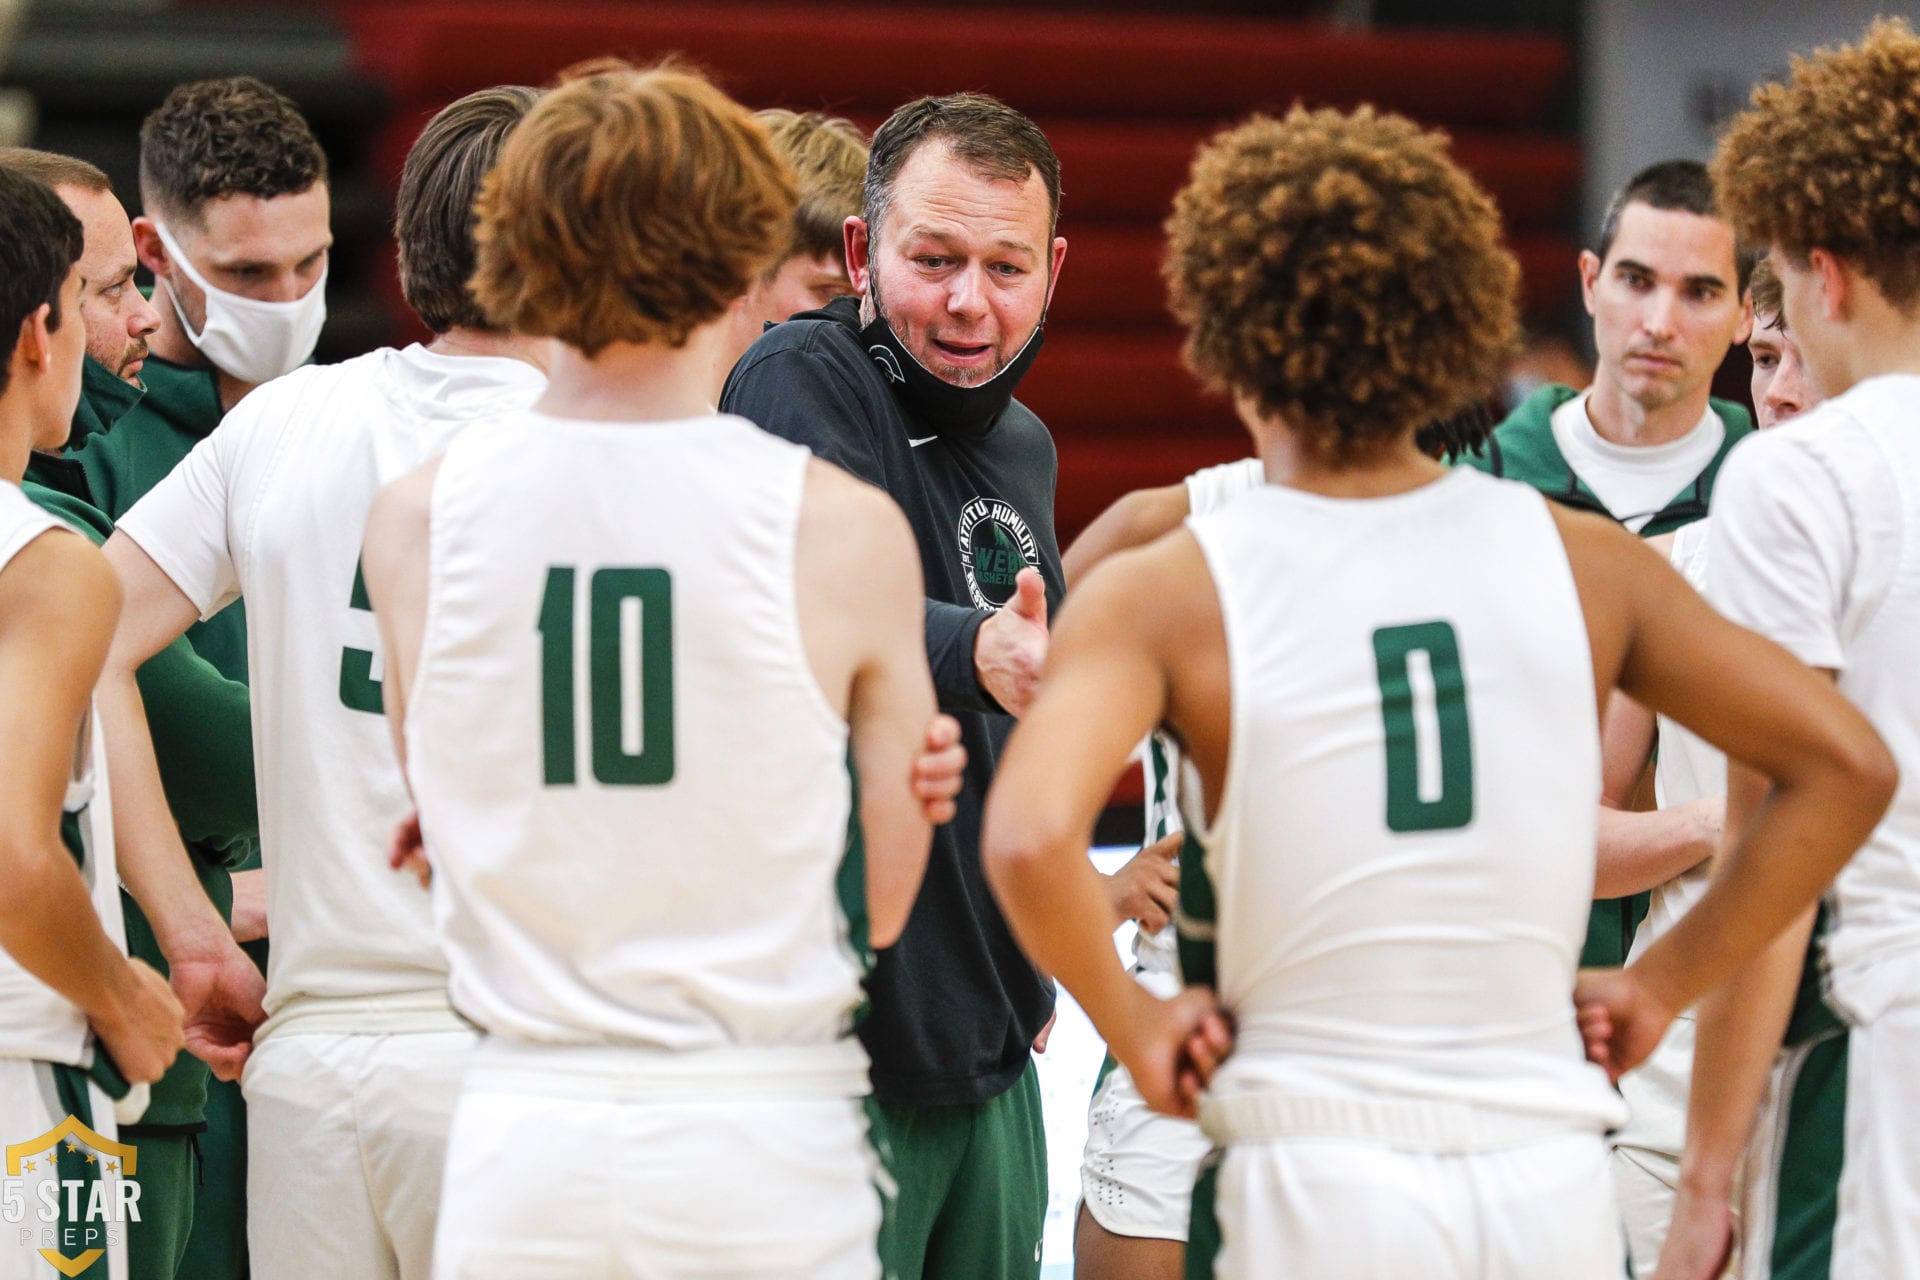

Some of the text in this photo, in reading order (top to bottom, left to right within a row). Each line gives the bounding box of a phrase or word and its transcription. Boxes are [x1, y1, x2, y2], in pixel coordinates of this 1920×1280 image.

[960, 501, 988, 549] ATTITU
[991, 503, 1036, 558] HUMILITY
[974, 546, 1019, 574] WEB
[537, 566, 675, 785] 10
[1372, 621, 1474, 832] 0
